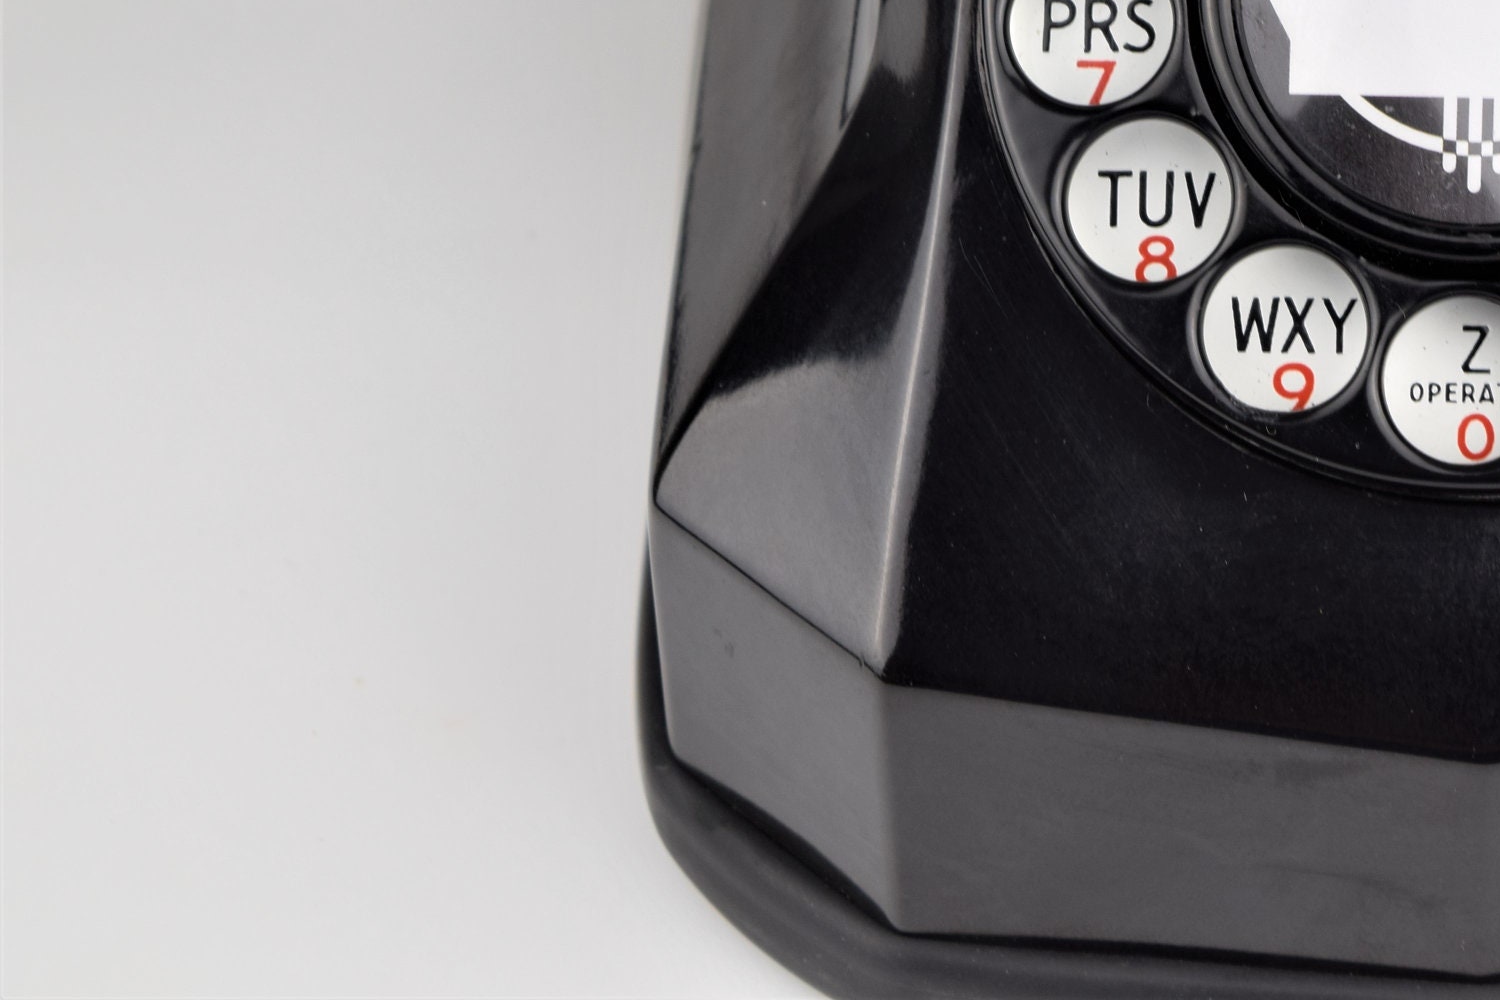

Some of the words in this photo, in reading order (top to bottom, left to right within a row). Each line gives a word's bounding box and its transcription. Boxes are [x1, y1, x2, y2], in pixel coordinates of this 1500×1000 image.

[1076, 60, 1116, 107] 7
[1097, 170, 1217, 228] TUV
[1134, 235, 1177, 283] 8
[1231, 296, 1358, 354] WXY
[1461, 324, 1491, 374] Z
[1272, 362, 1315, 412] 9
[1457, 413, 1495, 462] 0
